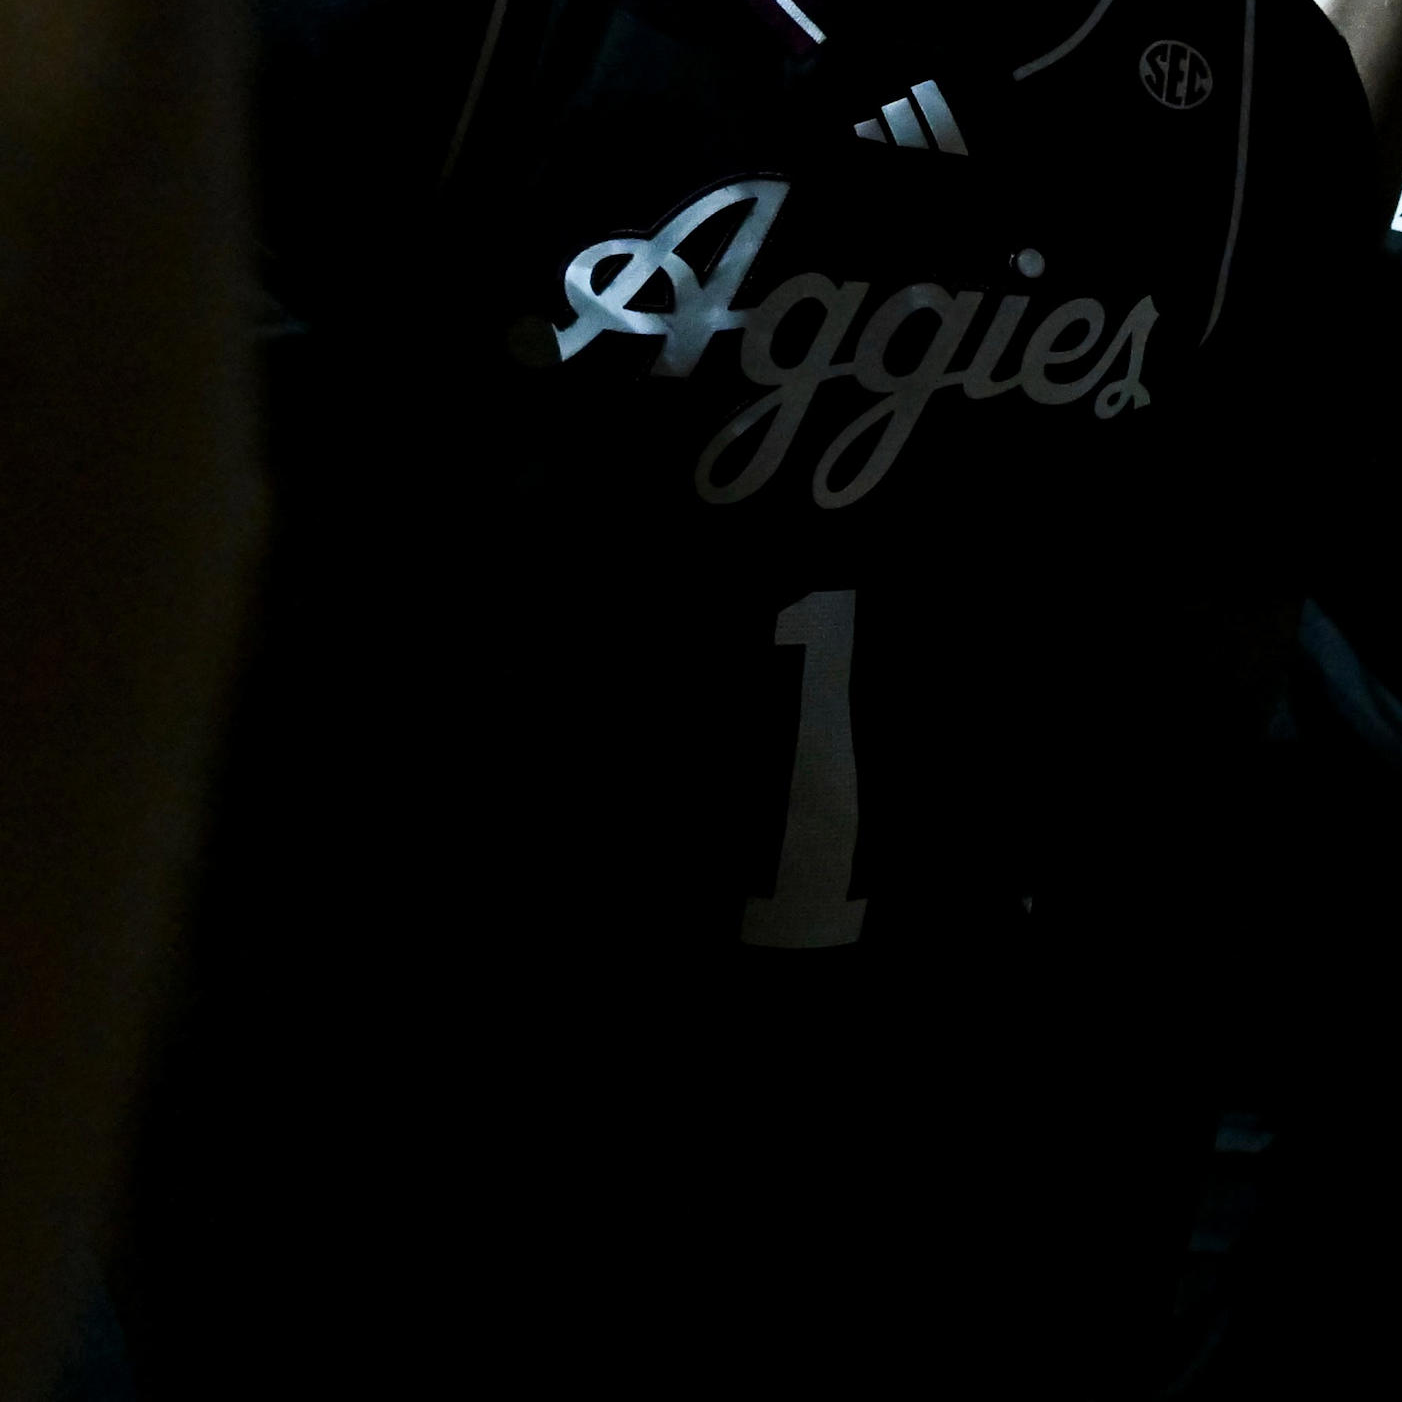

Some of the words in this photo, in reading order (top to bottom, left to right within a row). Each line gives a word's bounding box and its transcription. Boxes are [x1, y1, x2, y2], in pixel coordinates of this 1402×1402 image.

[1142, 42, 1213, 109] SEC
[550, 174, 1161, 510] Aggies
[738, 588, 870, 951] 1
